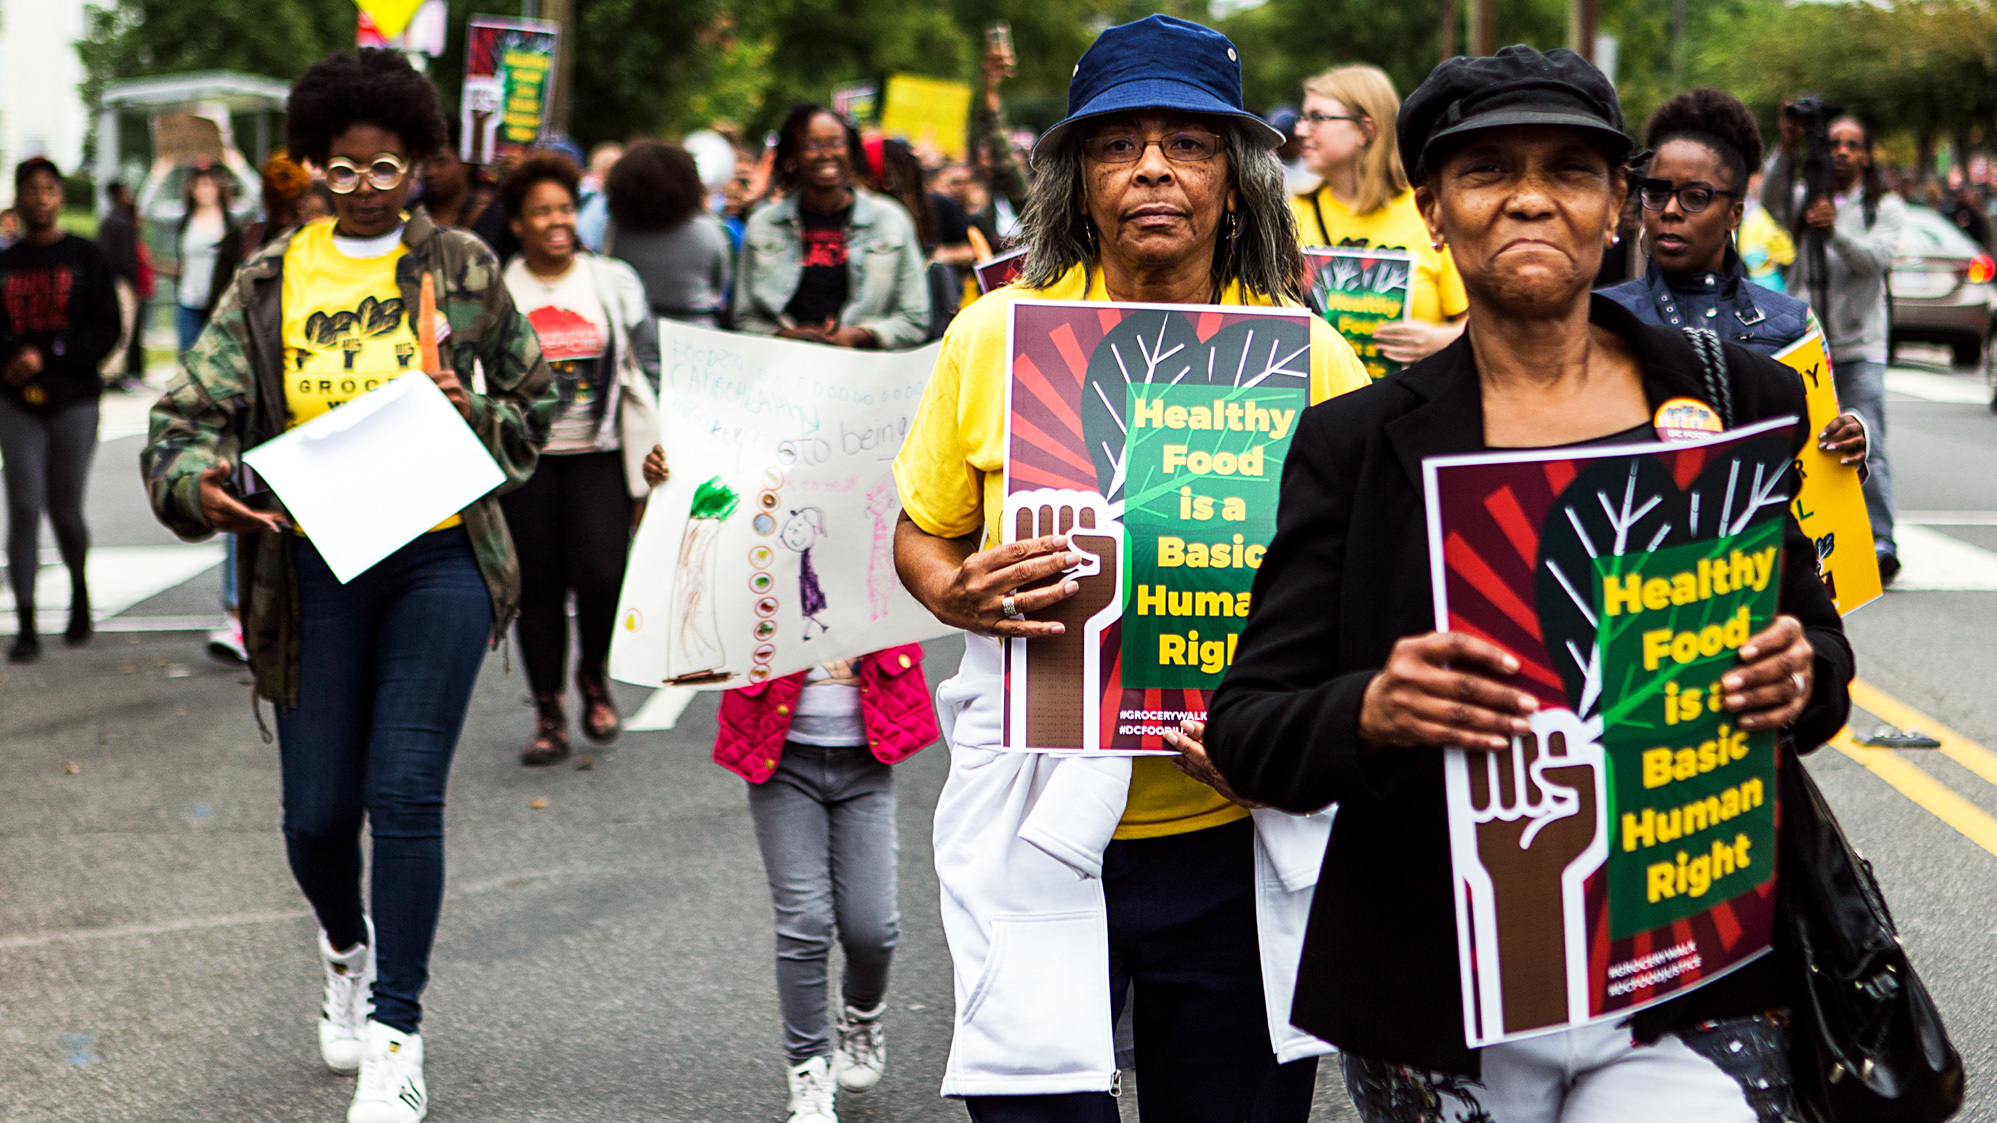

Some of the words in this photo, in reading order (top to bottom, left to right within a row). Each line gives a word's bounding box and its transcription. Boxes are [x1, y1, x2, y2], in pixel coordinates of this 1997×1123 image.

[1328, 291, 1402, 319] Healthy
[1338, 314, 1386, 334] Foo
[299, 379, 398, 394] GROC
[1134, 397, 1296, 440] Healthy
[1162, 444, 1264, 477] Food
[1179, 485, 1215, 521] is
[1221, 496, 1247, 521] a
[1157, 533, 1267, 569] Basic
[1602, 546, 1777, 617] Healthy
[1137, 584, 1253, 618] Huma
[1642, 604, 1751, 672] Food
[1119, 709, 1208, 721] #GROCERYWALK
[1664, 680, 1703, 726] is
[1641, 723, 1750, 789] Basic
[1621, 776, 1765, 853] Human
[1646, 832, 1752, 904] Right
